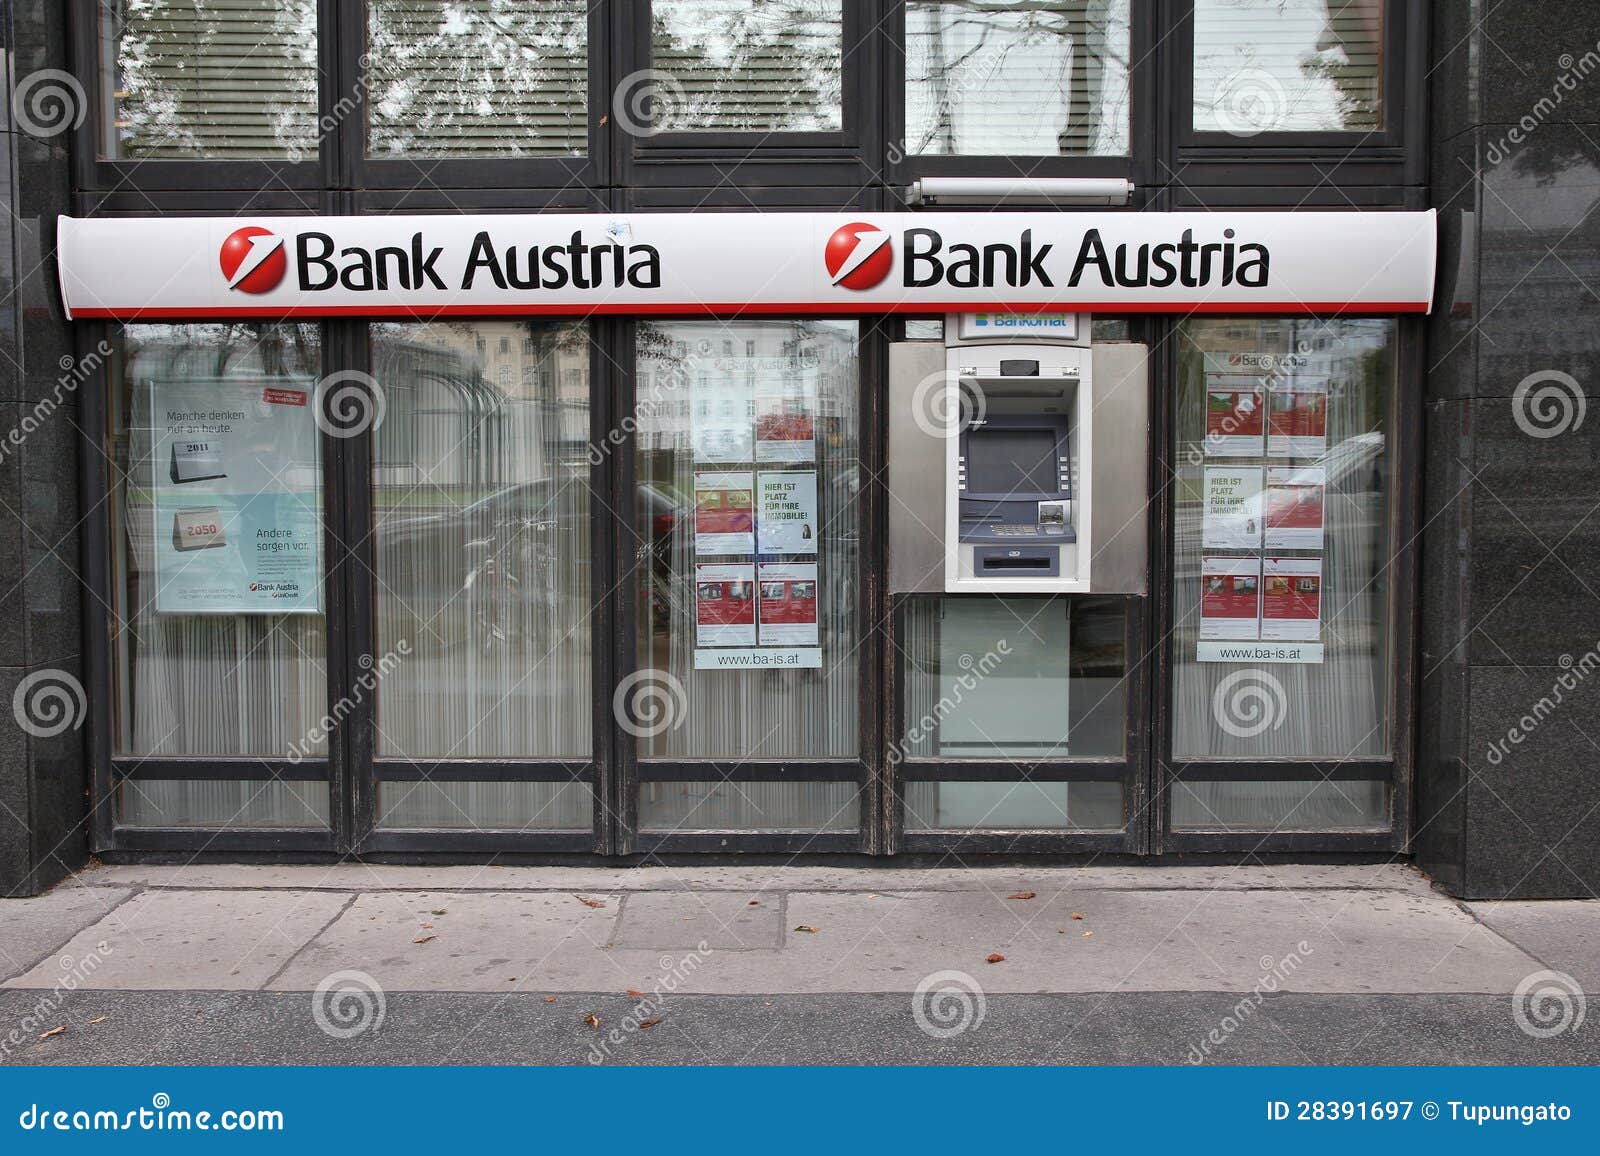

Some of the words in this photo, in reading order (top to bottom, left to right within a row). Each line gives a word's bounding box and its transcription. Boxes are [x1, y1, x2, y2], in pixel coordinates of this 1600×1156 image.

[296, 231, 448, 291] Bank
[460, 230, 661, 289] Austria
[902, 228, 1054, 287] Bank
[1067, 228, 1270, 287] Austria
[994, 313, 1067, 327] Bankomat
[1242, 354, 1269, 367] Ban
[166, 410, 206, 421] Manche
[208, 410, 245, 421] denken
[167, 425, 185, 434] nur
[187, 425, 199, 433] an
[202, 424, 233, 433] heute.
[186, 443, 209, 452] 2011
[764, 483, 781, 491] HIER
[784, 483, 796, 491] IST
[1211, 478, 1228, 486] HIER
[1230, 478, 1242, 486] IST
[1210, 487, 1233, 495] PLATZ
[764, 493, 787, 501] PLATZ
[765, 501, 780, 510] FÜR
[782, 502, 799, 510] IHRE
[187, 524, 217, 536] 2050
[256, 528, 292, 538] Andere
[256, 543, 290, 552] sorgen
[1220, 648, 1301, 659] www.ba-is.at
[718, 653, 799, 665] www.ba-is.at
